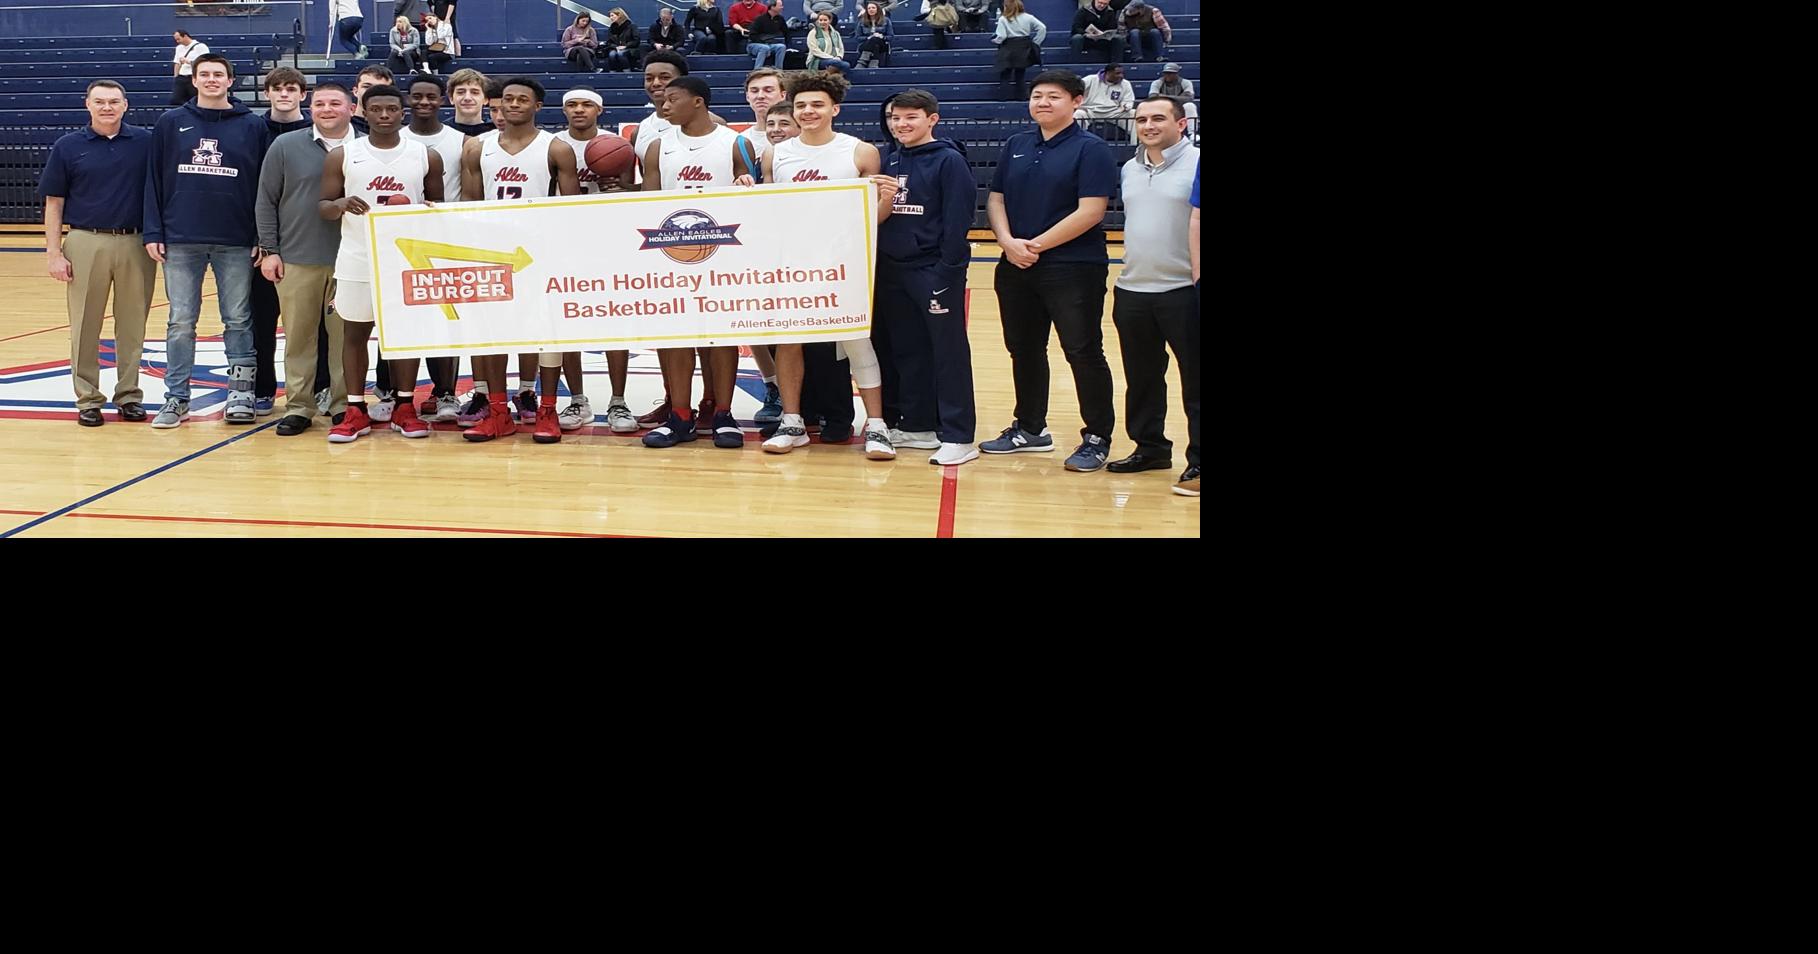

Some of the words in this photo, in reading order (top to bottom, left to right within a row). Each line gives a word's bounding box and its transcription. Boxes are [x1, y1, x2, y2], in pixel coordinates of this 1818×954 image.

[197, 167, 237, 176] BASKETBALL
[494, 167, 529, 182] Allen
[677, 166, 713, 181] Allen
[366, 176, 405, 191] Allen
[648, 235, 680, 243] HOLIDAY
[682, 233, 733, 241] INVITATIONAL
[411, 269, 506, 287] IN-N-OUT
[545, 276, 606, 294] Allen
[613, 272, 703, 293] Holiday
[709, 264, 846, 287] Invitational
[413, 283, 507, 301] BURGER
[563, 297, 686, 319] Basketball
[693, 292, 839, 313] Tournament
[730, 314, 867, 329] #AllenEaglesBasketball
